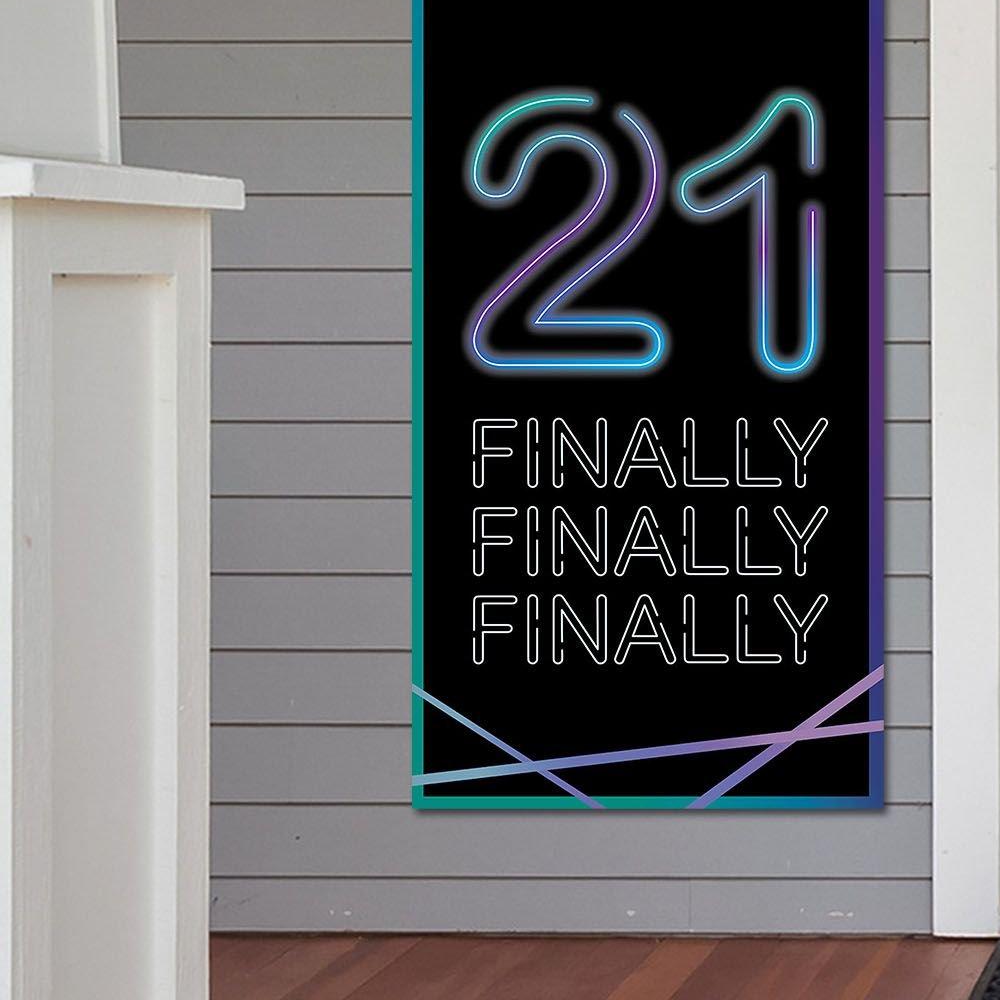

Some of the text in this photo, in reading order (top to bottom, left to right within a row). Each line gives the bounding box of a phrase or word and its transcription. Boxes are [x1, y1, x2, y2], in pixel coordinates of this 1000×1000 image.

[468, 90, 824, 378] 21
[472, 416, 829, 489] FINALLY
[472, 505, 829, 577] FINALLY
[472, 593, 829, 666] FINALLY
